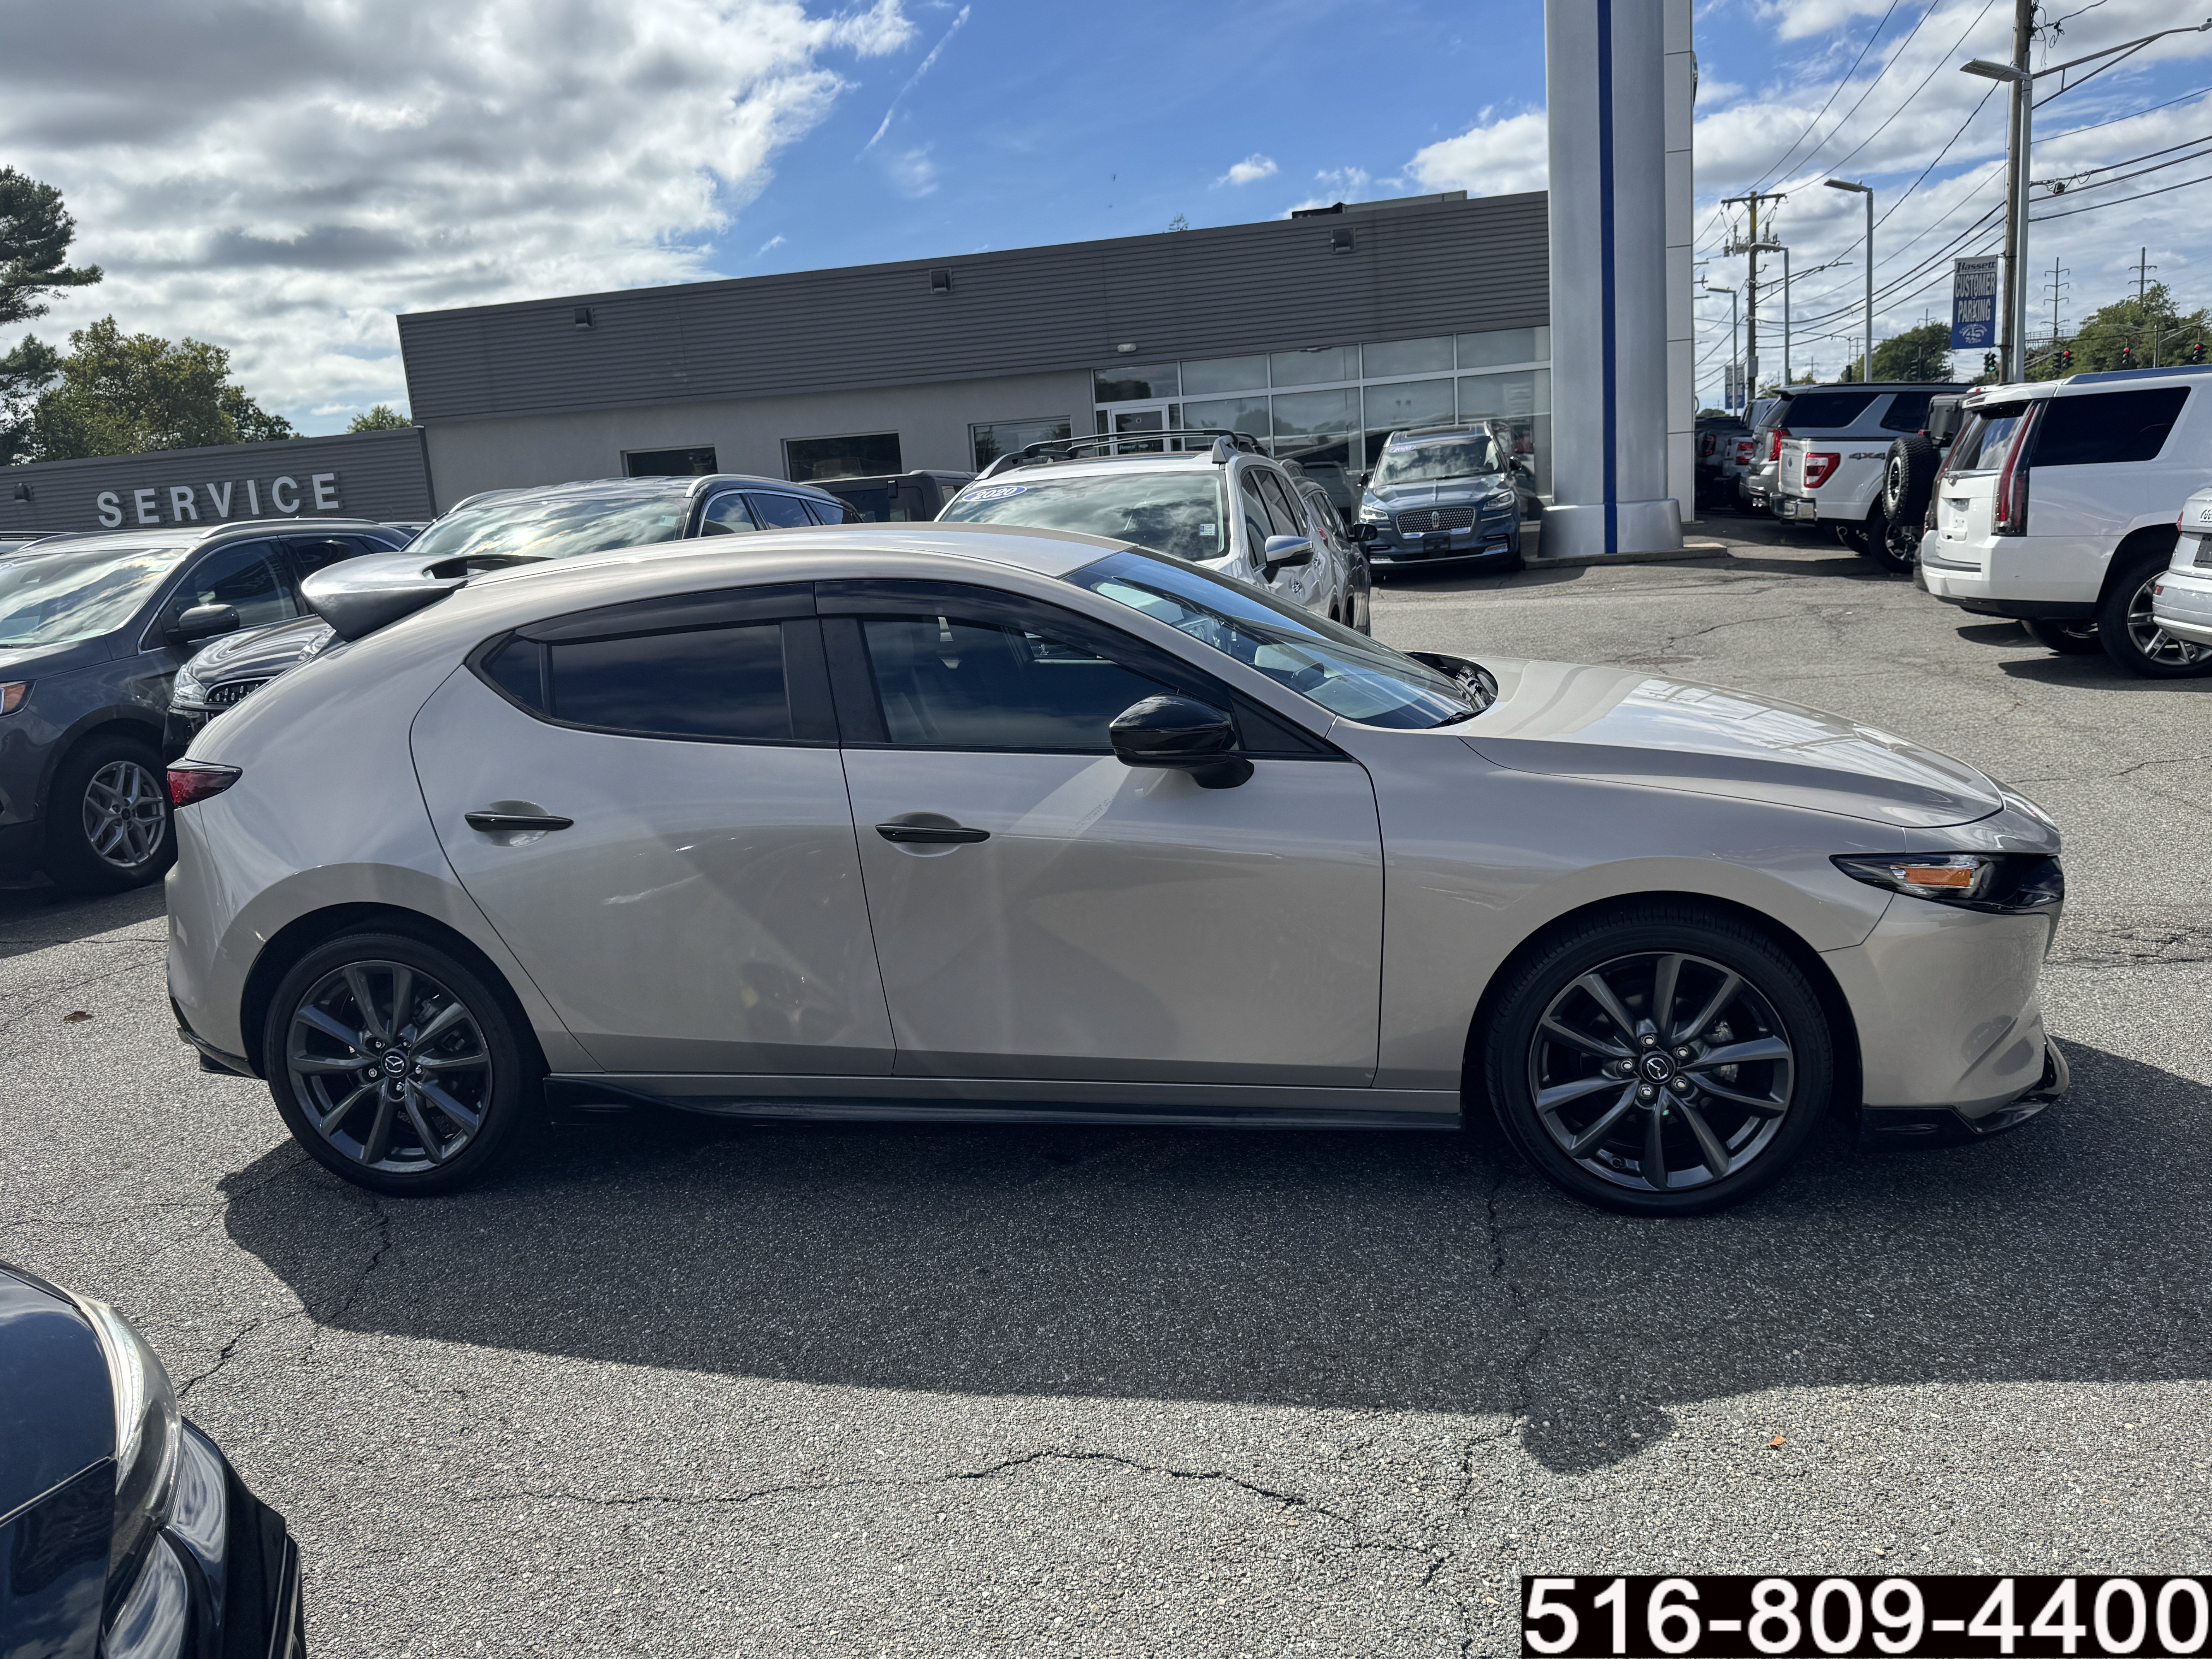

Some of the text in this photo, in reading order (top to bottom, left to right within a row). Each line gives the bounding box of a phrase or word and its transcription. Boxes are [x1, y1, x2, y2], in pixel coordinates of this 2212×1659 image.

[1957, 261, 1996, 273] Hassett
[1955, 273, 1995, 298] CUSTOMER
[1958, 298, 1990, 323] PARKING
[97, 472, 339, 528] SERVICE
[970, 487, 1018, 500] 2020
